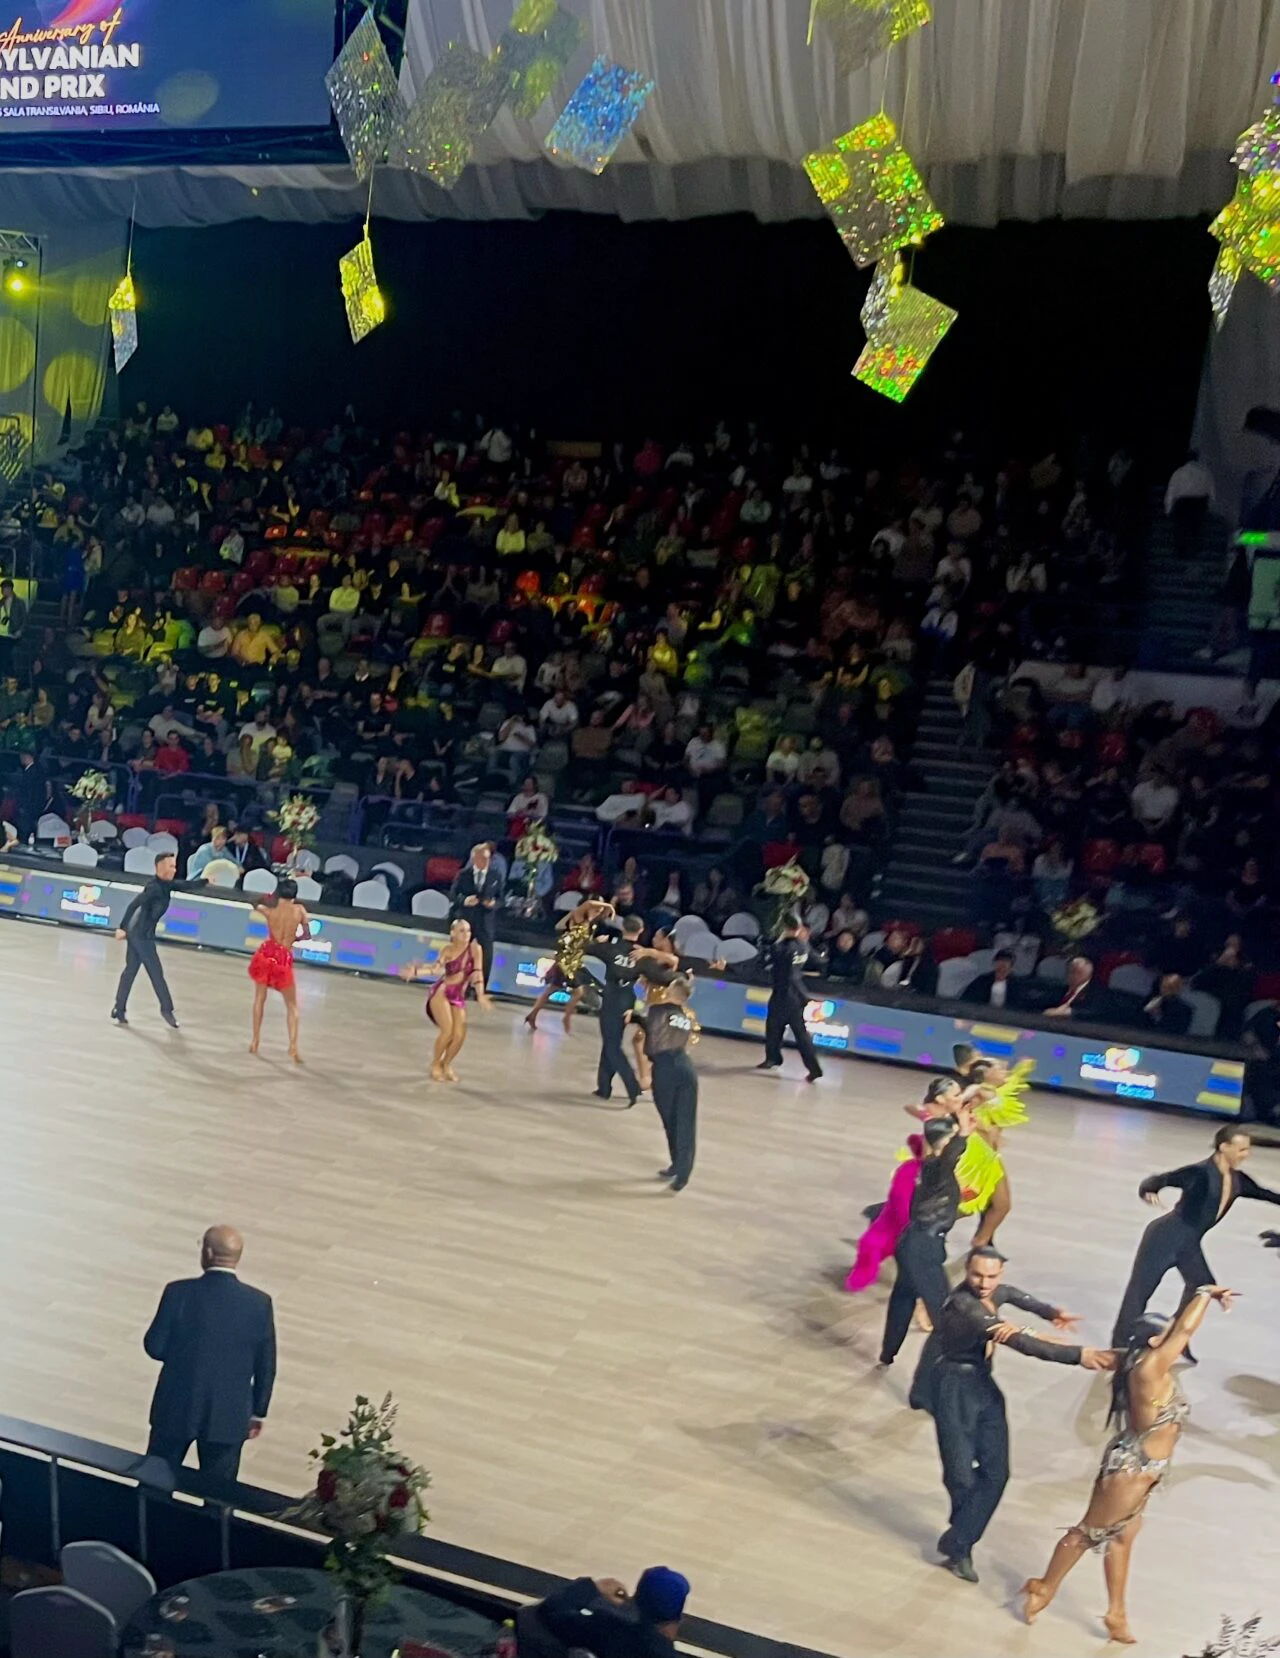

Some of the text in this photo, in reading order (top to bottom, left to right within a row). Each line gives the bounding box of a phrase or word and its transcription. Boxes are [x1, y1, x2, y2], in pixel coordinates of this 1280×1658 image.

[100, 8, 122, 46] of
[44, 74, 106, 99] PRIX
[3, 107, 25, 117] SALA
